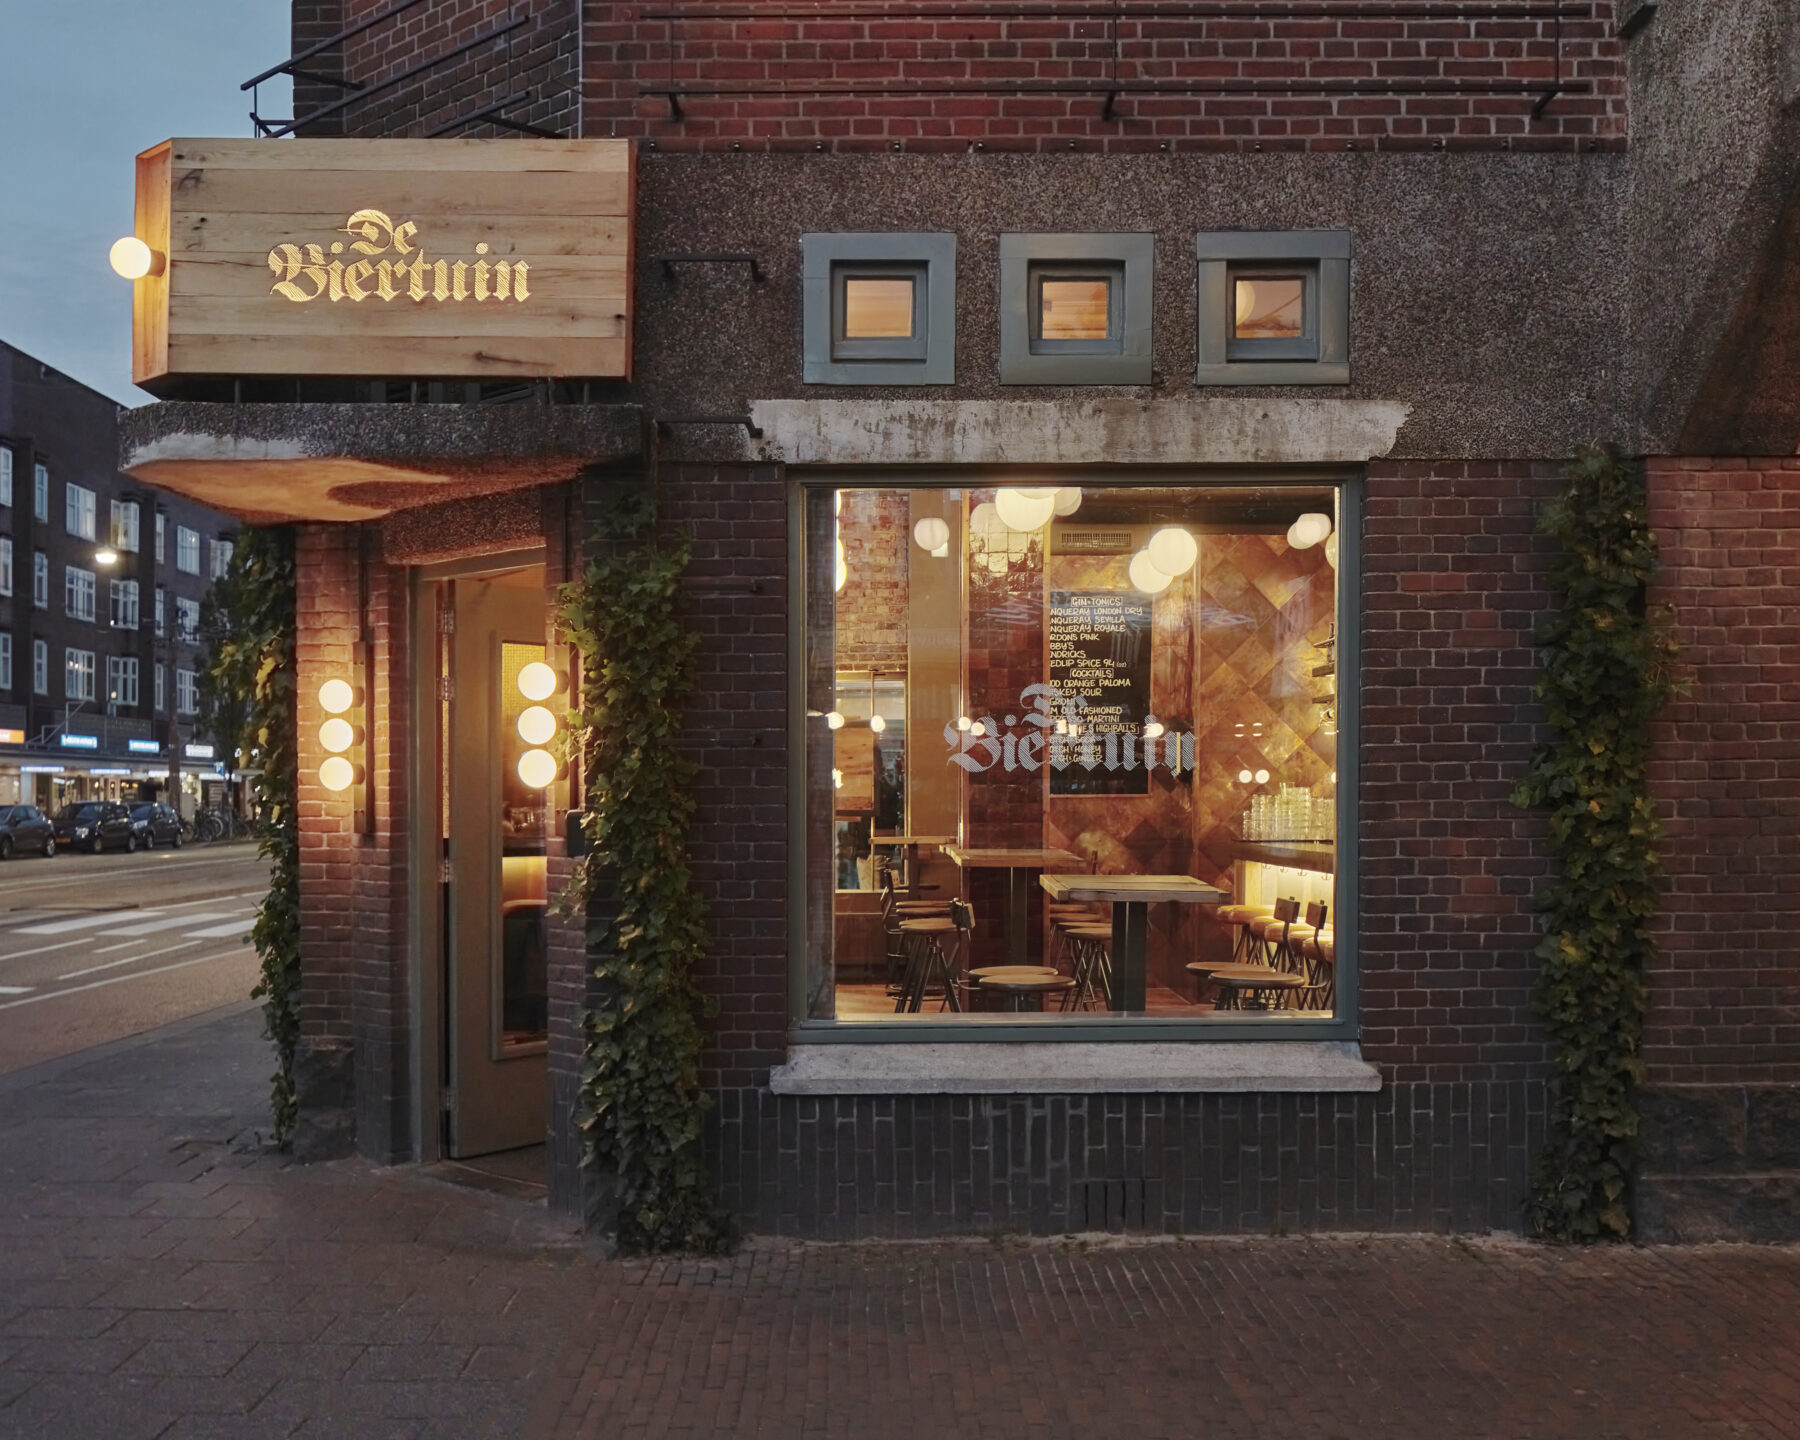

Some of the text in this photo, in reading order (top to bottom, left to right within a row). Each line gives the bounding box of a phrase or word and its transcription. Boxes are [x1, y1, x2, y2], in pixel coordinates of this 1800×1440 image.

[345, 209, 418, 255] De
[268, 241, 532, 302] Biertuin
[1050, 607, 1143, 616] NQUERAY LONDON DRY
[1050, 615, 1126, 624] NQUERAY SEVILLA
[1050, 624, 1126, 633] NQUERAY ROYALE
[1080, 633, 1100, 641] PINK
[1050, 642, 1075, 650] BBY'S
[1050, 650, 1086, 659] NDRICKS
[1050, 659, 1075, 668] EDLIP
[1077, 659, 1101, 668] SPICE
[1103, 658, 1115, 668] 94
[1071, 669, 1113, 678] COCKTAILS
[1064, 680, 1096, 688] ORANGE
[1099, 679, 1131, 688] PALOMA
[1080, 688, 1103, 697] SOUR
[1079, 706, 1123, 715] FASHIONED
[1087, 715, 1120, 723] MARTINI
[1095, 724, 1137, 733] HIGHBALLS
